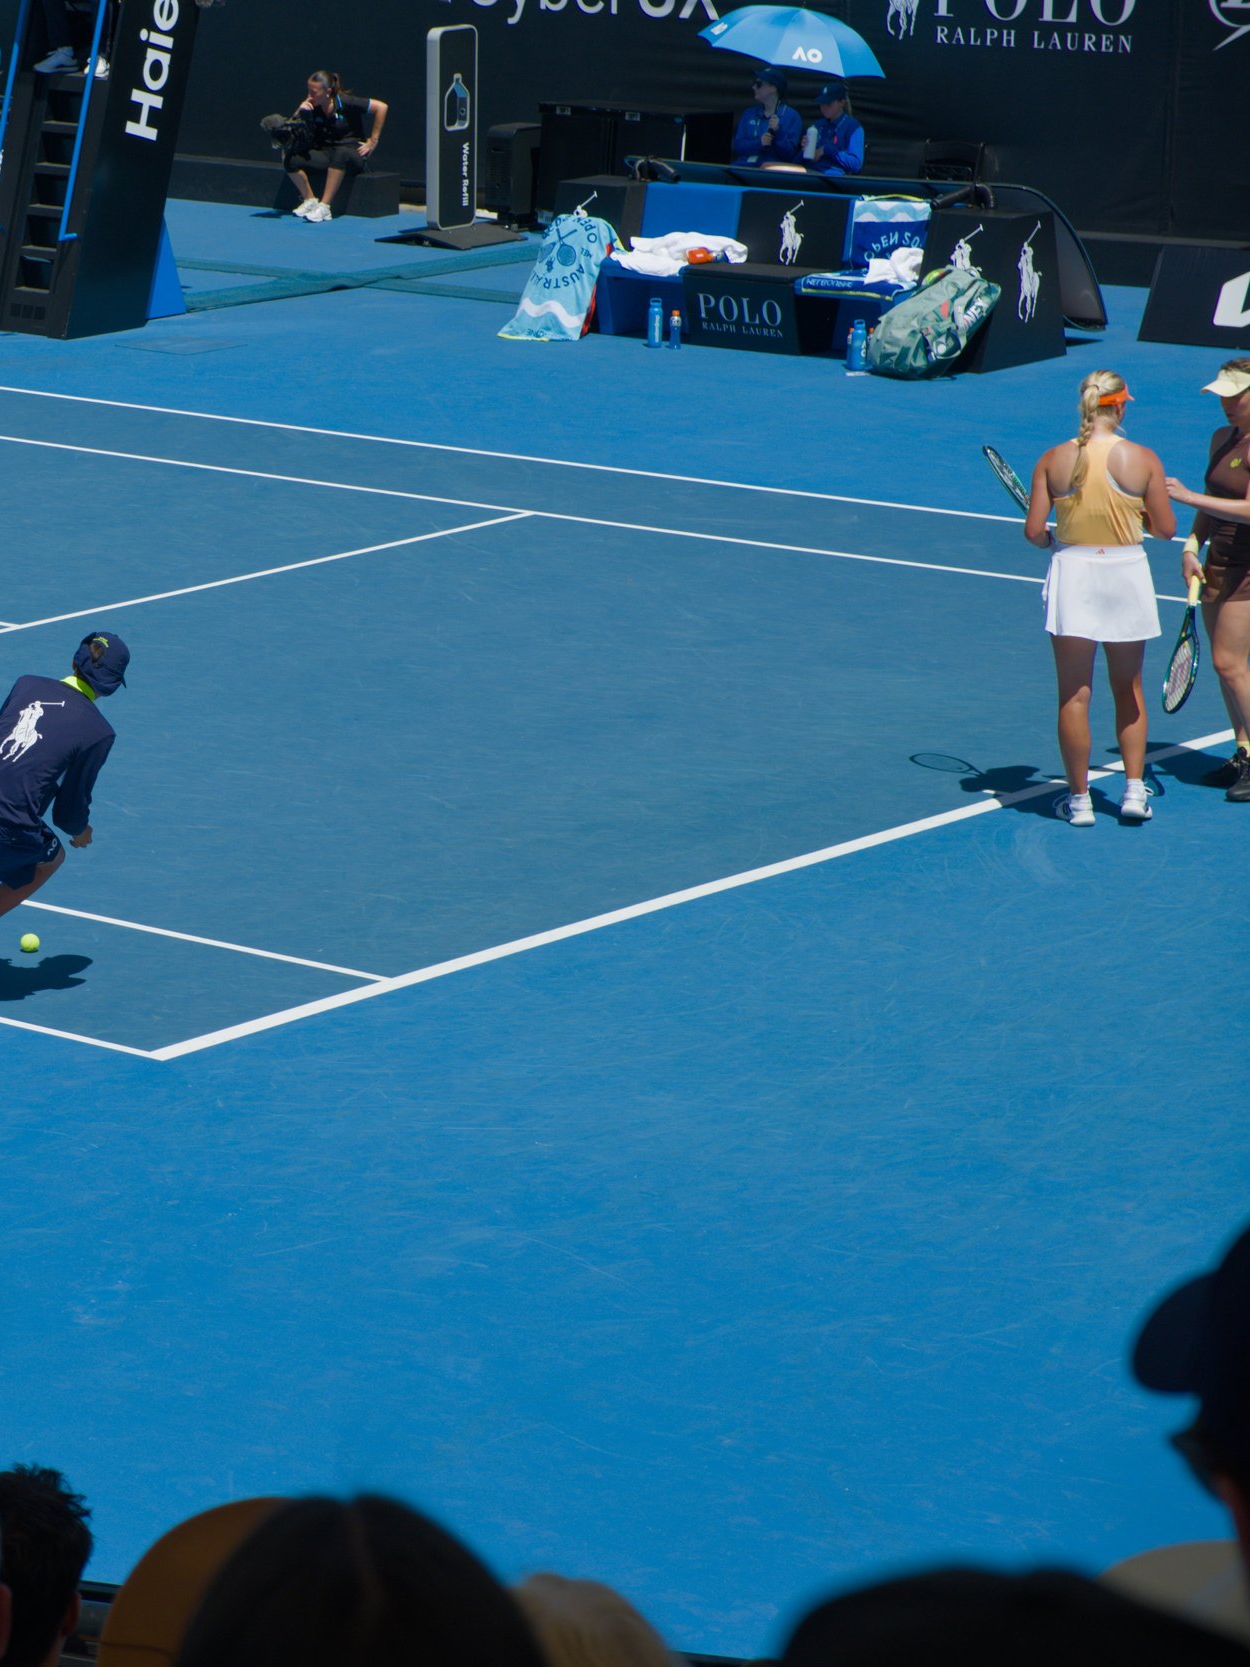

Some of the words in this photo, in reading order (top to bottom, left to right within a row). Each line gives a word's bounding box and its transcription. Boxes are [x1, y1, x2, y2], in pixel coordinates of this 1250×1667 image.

[935, 26, 1016, 48] RALPH
[1032, 30, 1134, 54] LAUREN
[792, 46, 823, 63] AO
[697, 292, 783, 327] POLO
[702, 321, 737, 332] RALPH
[742, 325, 783, 338] LAUREN
